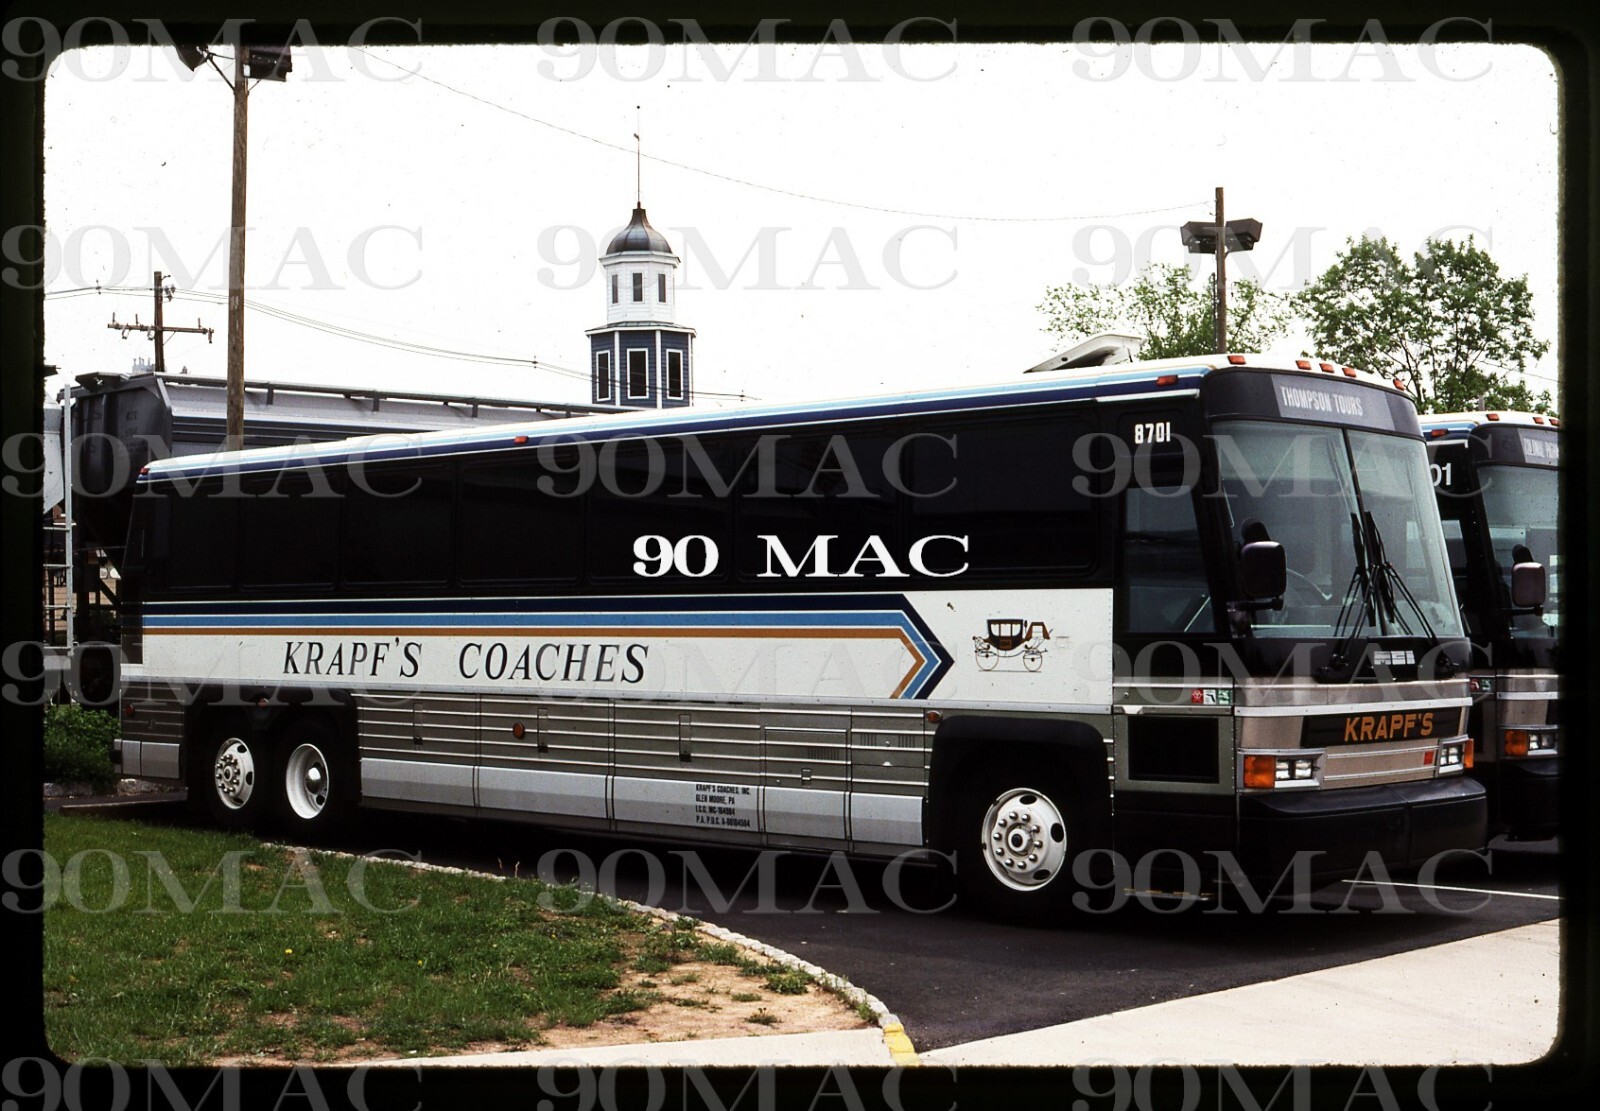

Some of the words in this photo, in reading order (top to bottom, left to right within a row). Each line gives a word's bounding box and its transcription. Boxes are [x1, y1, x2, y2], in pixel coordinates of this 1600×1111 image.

[1280, 386, 1332, 412] THOMPSON
[1332, 394, 1363, 416] TOURS
[1135, 421, 1170, 444] 8701
[283, 636, 422, 678] KRAPF'S
[458, 642, 649, 684] COACHES
[1343, 712, 1434, 742] KRAPF'S
[695, 783, 716, 793] KRAPF'S
[695, 794, 708, 802] GLEN
[728, 796, 735, 805] PA
